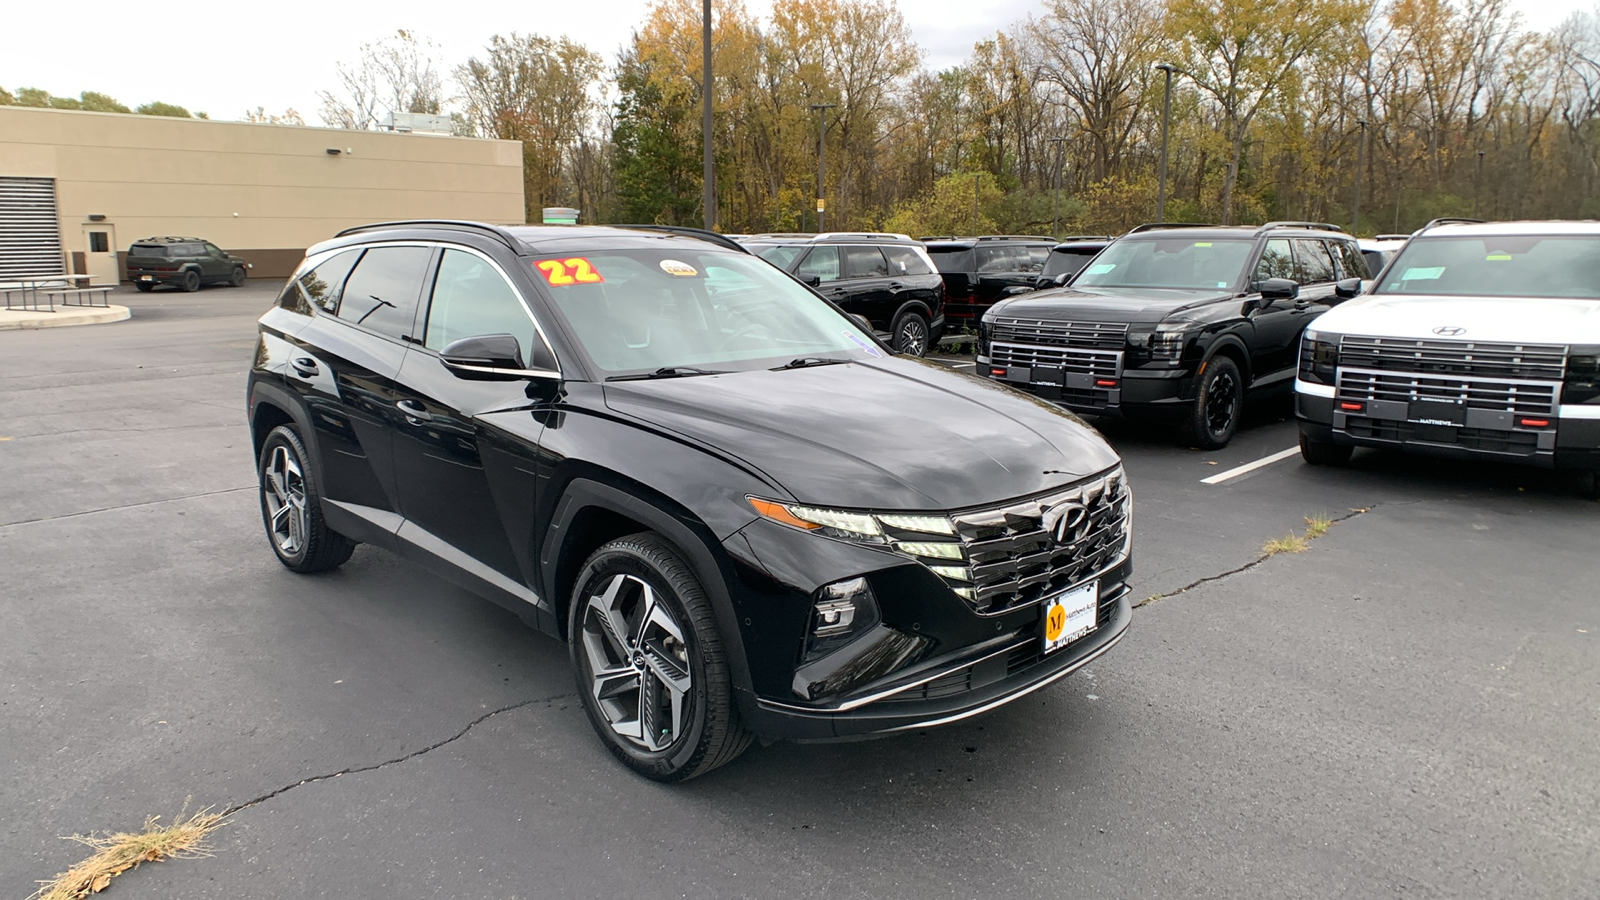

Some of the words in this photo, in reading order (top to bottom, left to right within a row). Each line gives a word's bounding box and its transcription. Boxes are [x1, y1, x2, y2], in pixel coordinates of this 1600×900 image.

[538, 257, 600, 285] 22
[1048, 612, 1063, 635] M
[1056, 628, 1087, 649] MATTHEWS
